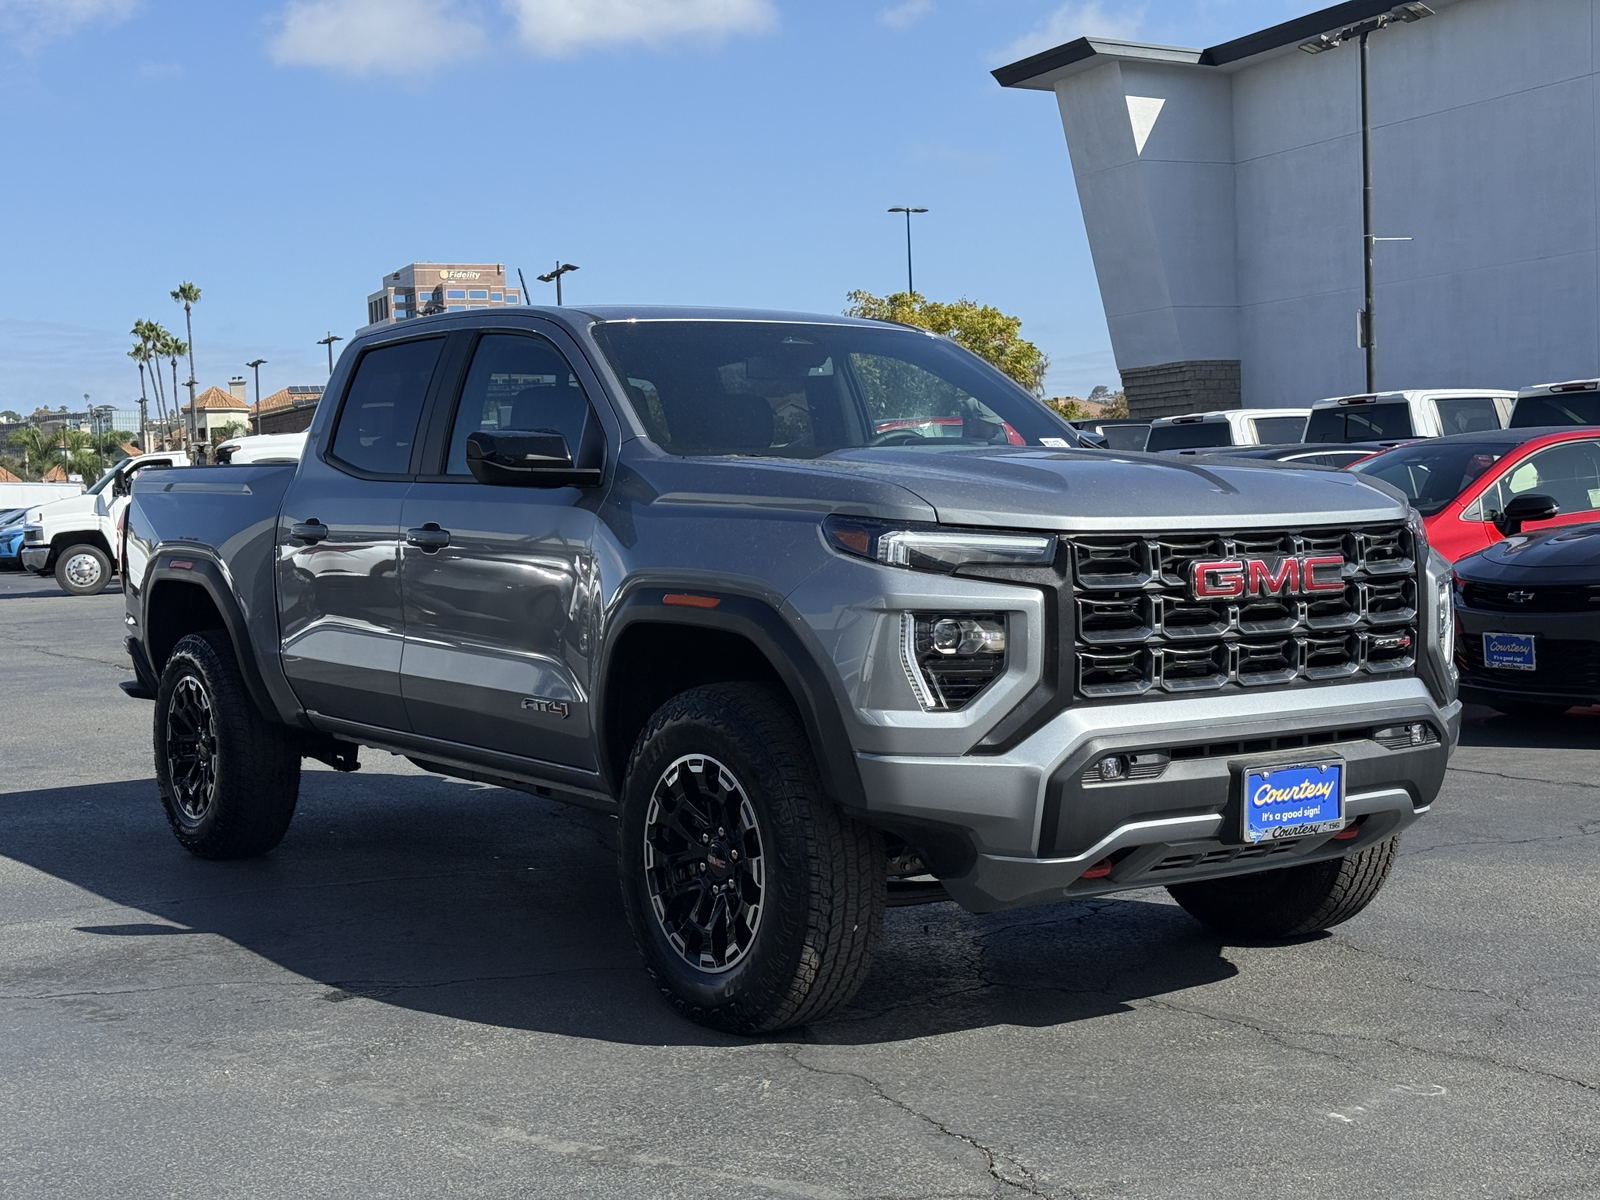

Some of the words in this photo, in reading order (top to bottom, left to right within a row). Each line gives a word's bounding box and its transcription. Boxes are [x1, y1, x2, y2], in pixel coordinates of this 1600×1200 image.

[449, 271, 481, 280] Fidelity
[1194, 556, 1345, 600] GMC
[1490, 641, 1530, 655] Courtesy
[1253, 778, 1335, 807] Courtesy
[1262, 811, 1273, 822] It's
[1274, 814, 1281, 822] a
[1282, 807, 1303, 822] good
[1303, 805, 1321, 819] sign!
[1272, 823, 1320, 838] Courtesy
[707, 853, 727, 869] GMC
